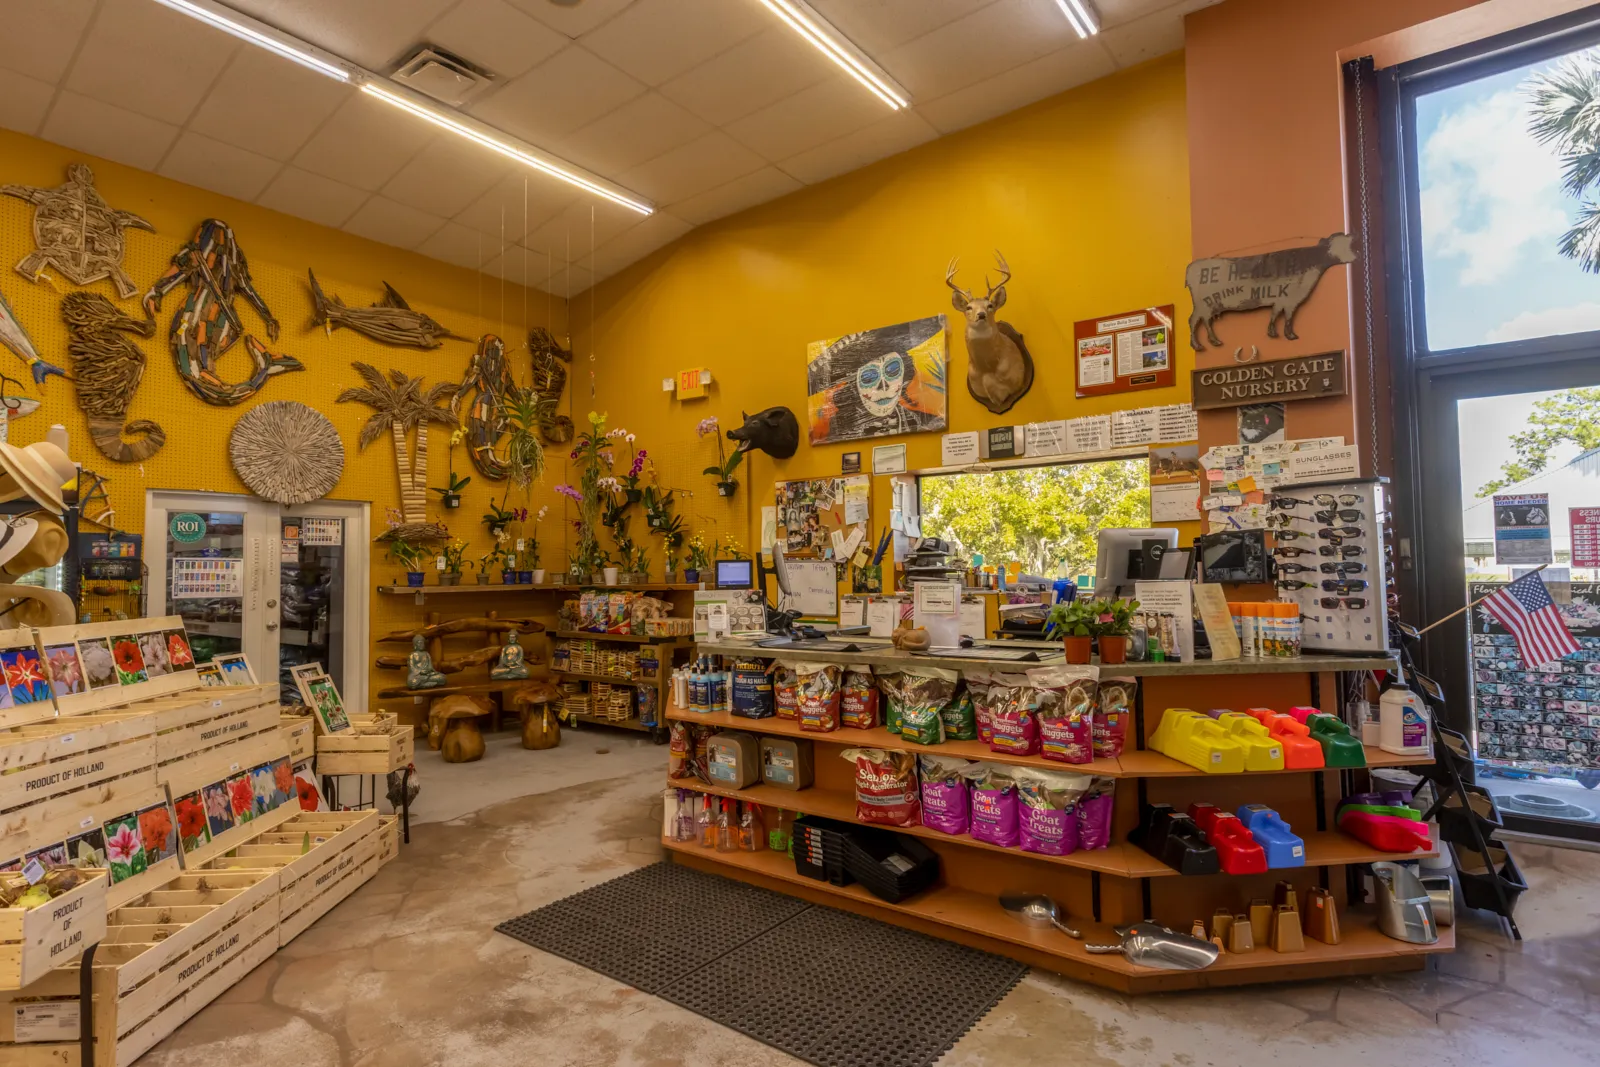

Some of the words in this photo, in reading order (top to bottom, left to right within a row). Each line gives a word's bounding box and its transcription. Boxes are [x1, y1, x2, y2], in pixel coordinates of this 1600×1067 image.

[1200, 267, 1220, 284] BE
[1203, 286, 1244, 308] DRINK
[1250, 284, 1290, 300] MILK
[681, 370, 700, 391] EXIT
[1200, 366, 1275, 386] GOLDEN
[1283, 358, 1335, 376] GATE
[1221, 377, 1311, 400] NURSERY
[1295, 451, 1352, 464] SUNGLASSES
[177, 521, 199, 532] ROI
[943, 712, 963, 720] ggets
[200, 728, 222, 741] PRODUCT
[222, 726, 228, 734] OF
[229, 720, 248, 731] HOLLAND
[993, 720, 1023, 733] Nuggets
[1042, 728, 1074, 739] Nuggets
[26, 773, 61, 791] PRODUCT
[62, 770, 72, 781] OF
[73, 761, 104, 778] HOLLAND
[923, 784, 942, 798] Goat
[974, 791, 996, 805] Goat
[973, 800, 1001, 815] Treats
[1029, 817, 1063, 835] Treats
[1031, 809, 1060, 826] Goat
[53, 897, 84, 921] PRODUCT
[63, 917, 72, 931] OF
[51, 931, 82, 957] HOLLAND
[178, 956, 205, 983] PRODUCT
[206, 950, 214, 963] OF
[215, 933, 239, 957] HOLLAND
